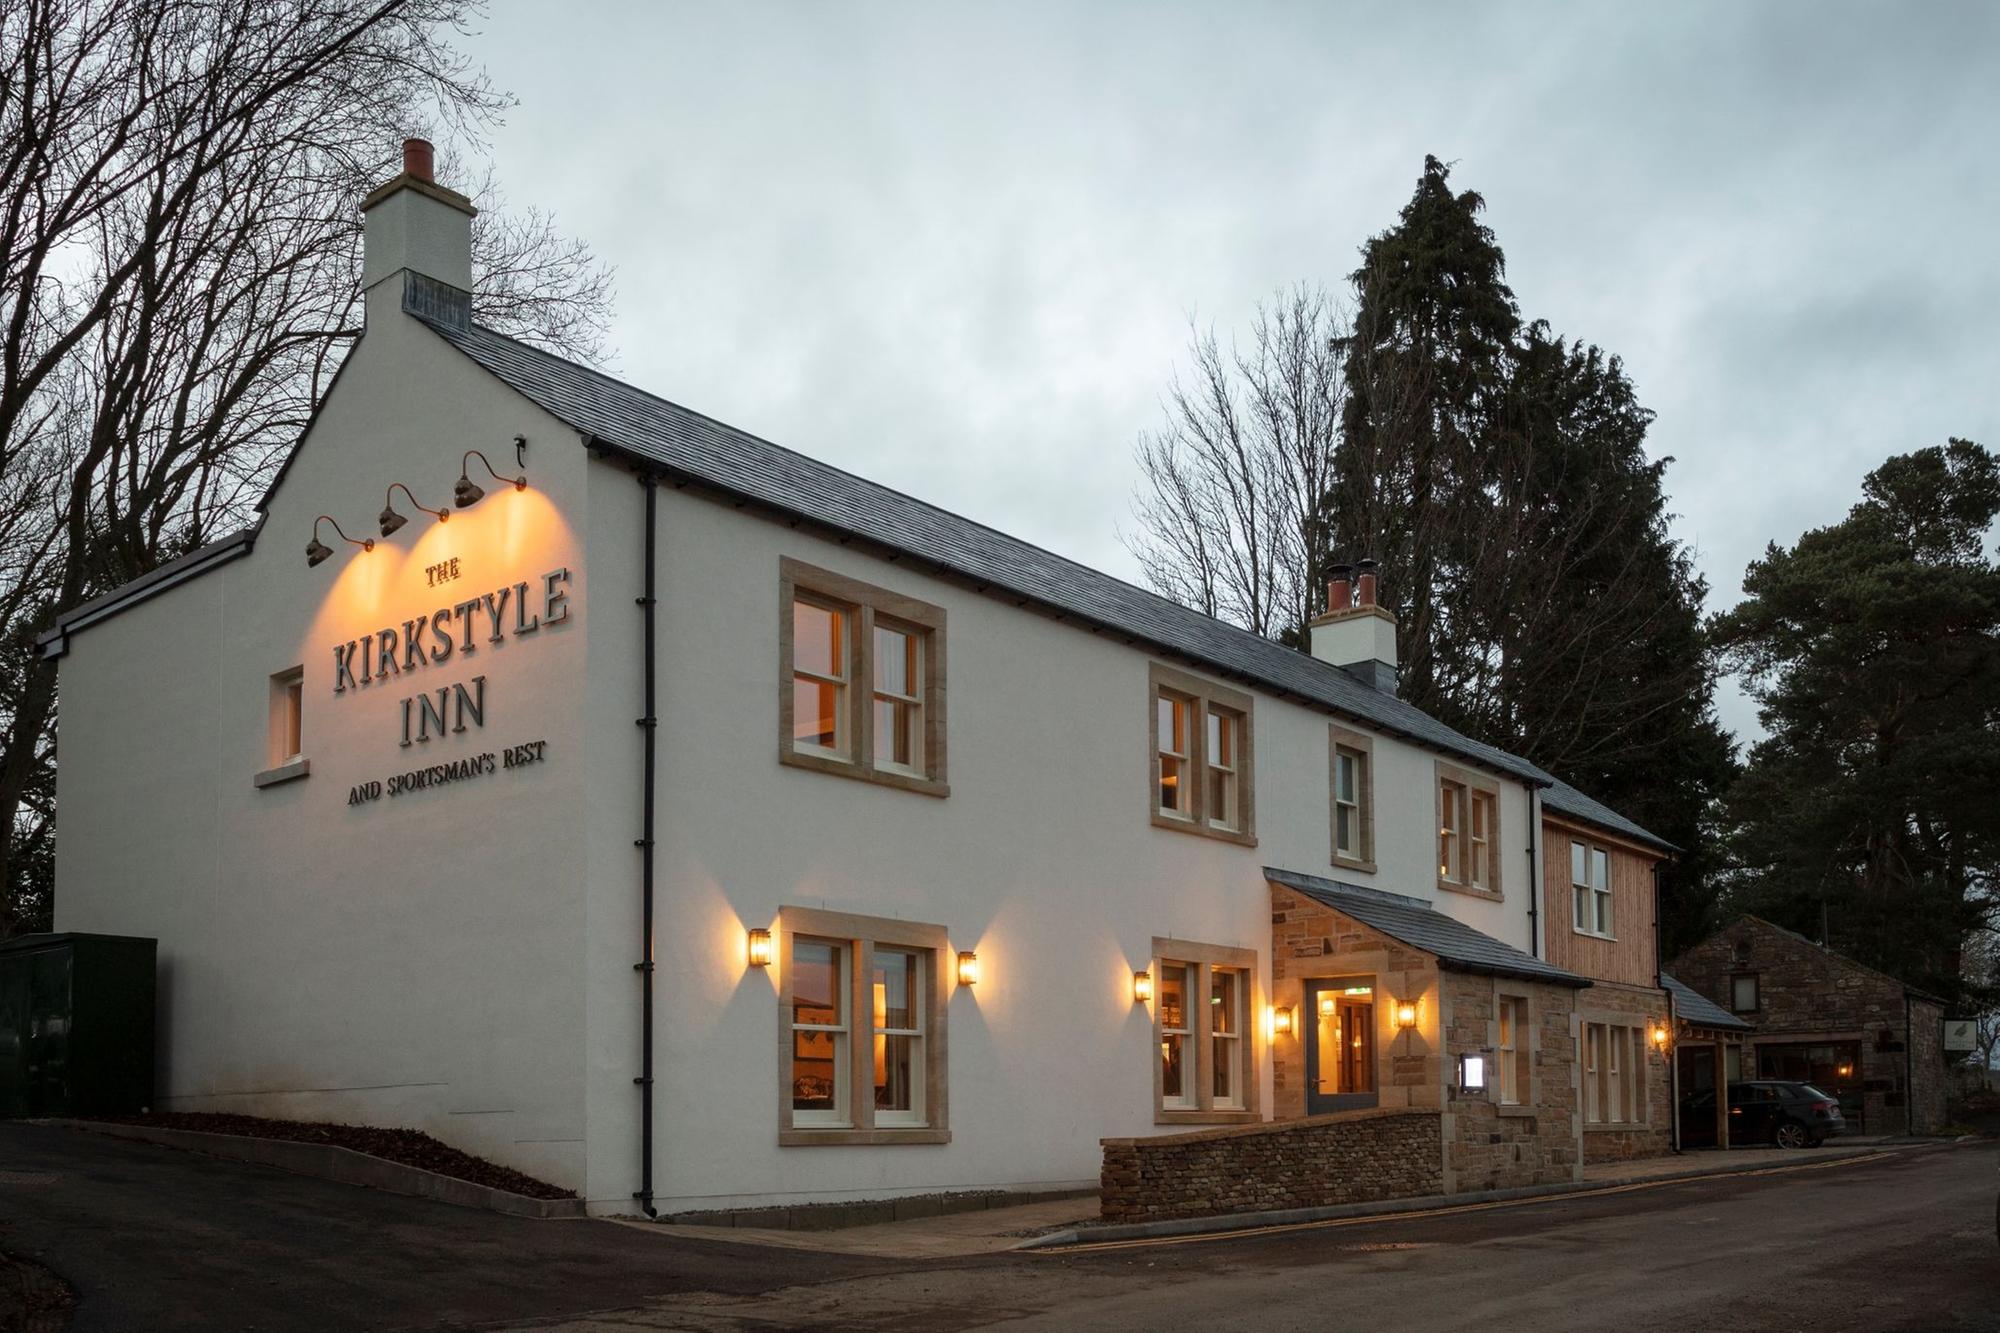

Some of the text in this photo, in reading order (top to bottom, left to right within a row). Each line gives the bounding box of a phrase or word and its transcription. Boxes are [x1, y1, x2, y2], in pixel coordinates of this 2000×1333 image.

[425, 557, 460, 587] THE
[333, 567, 570, 693] KIRKSTYLE
[399, 675, 486, 748] INN
[348, 740, 546, 805] AND SPORTSMAN'S REST
